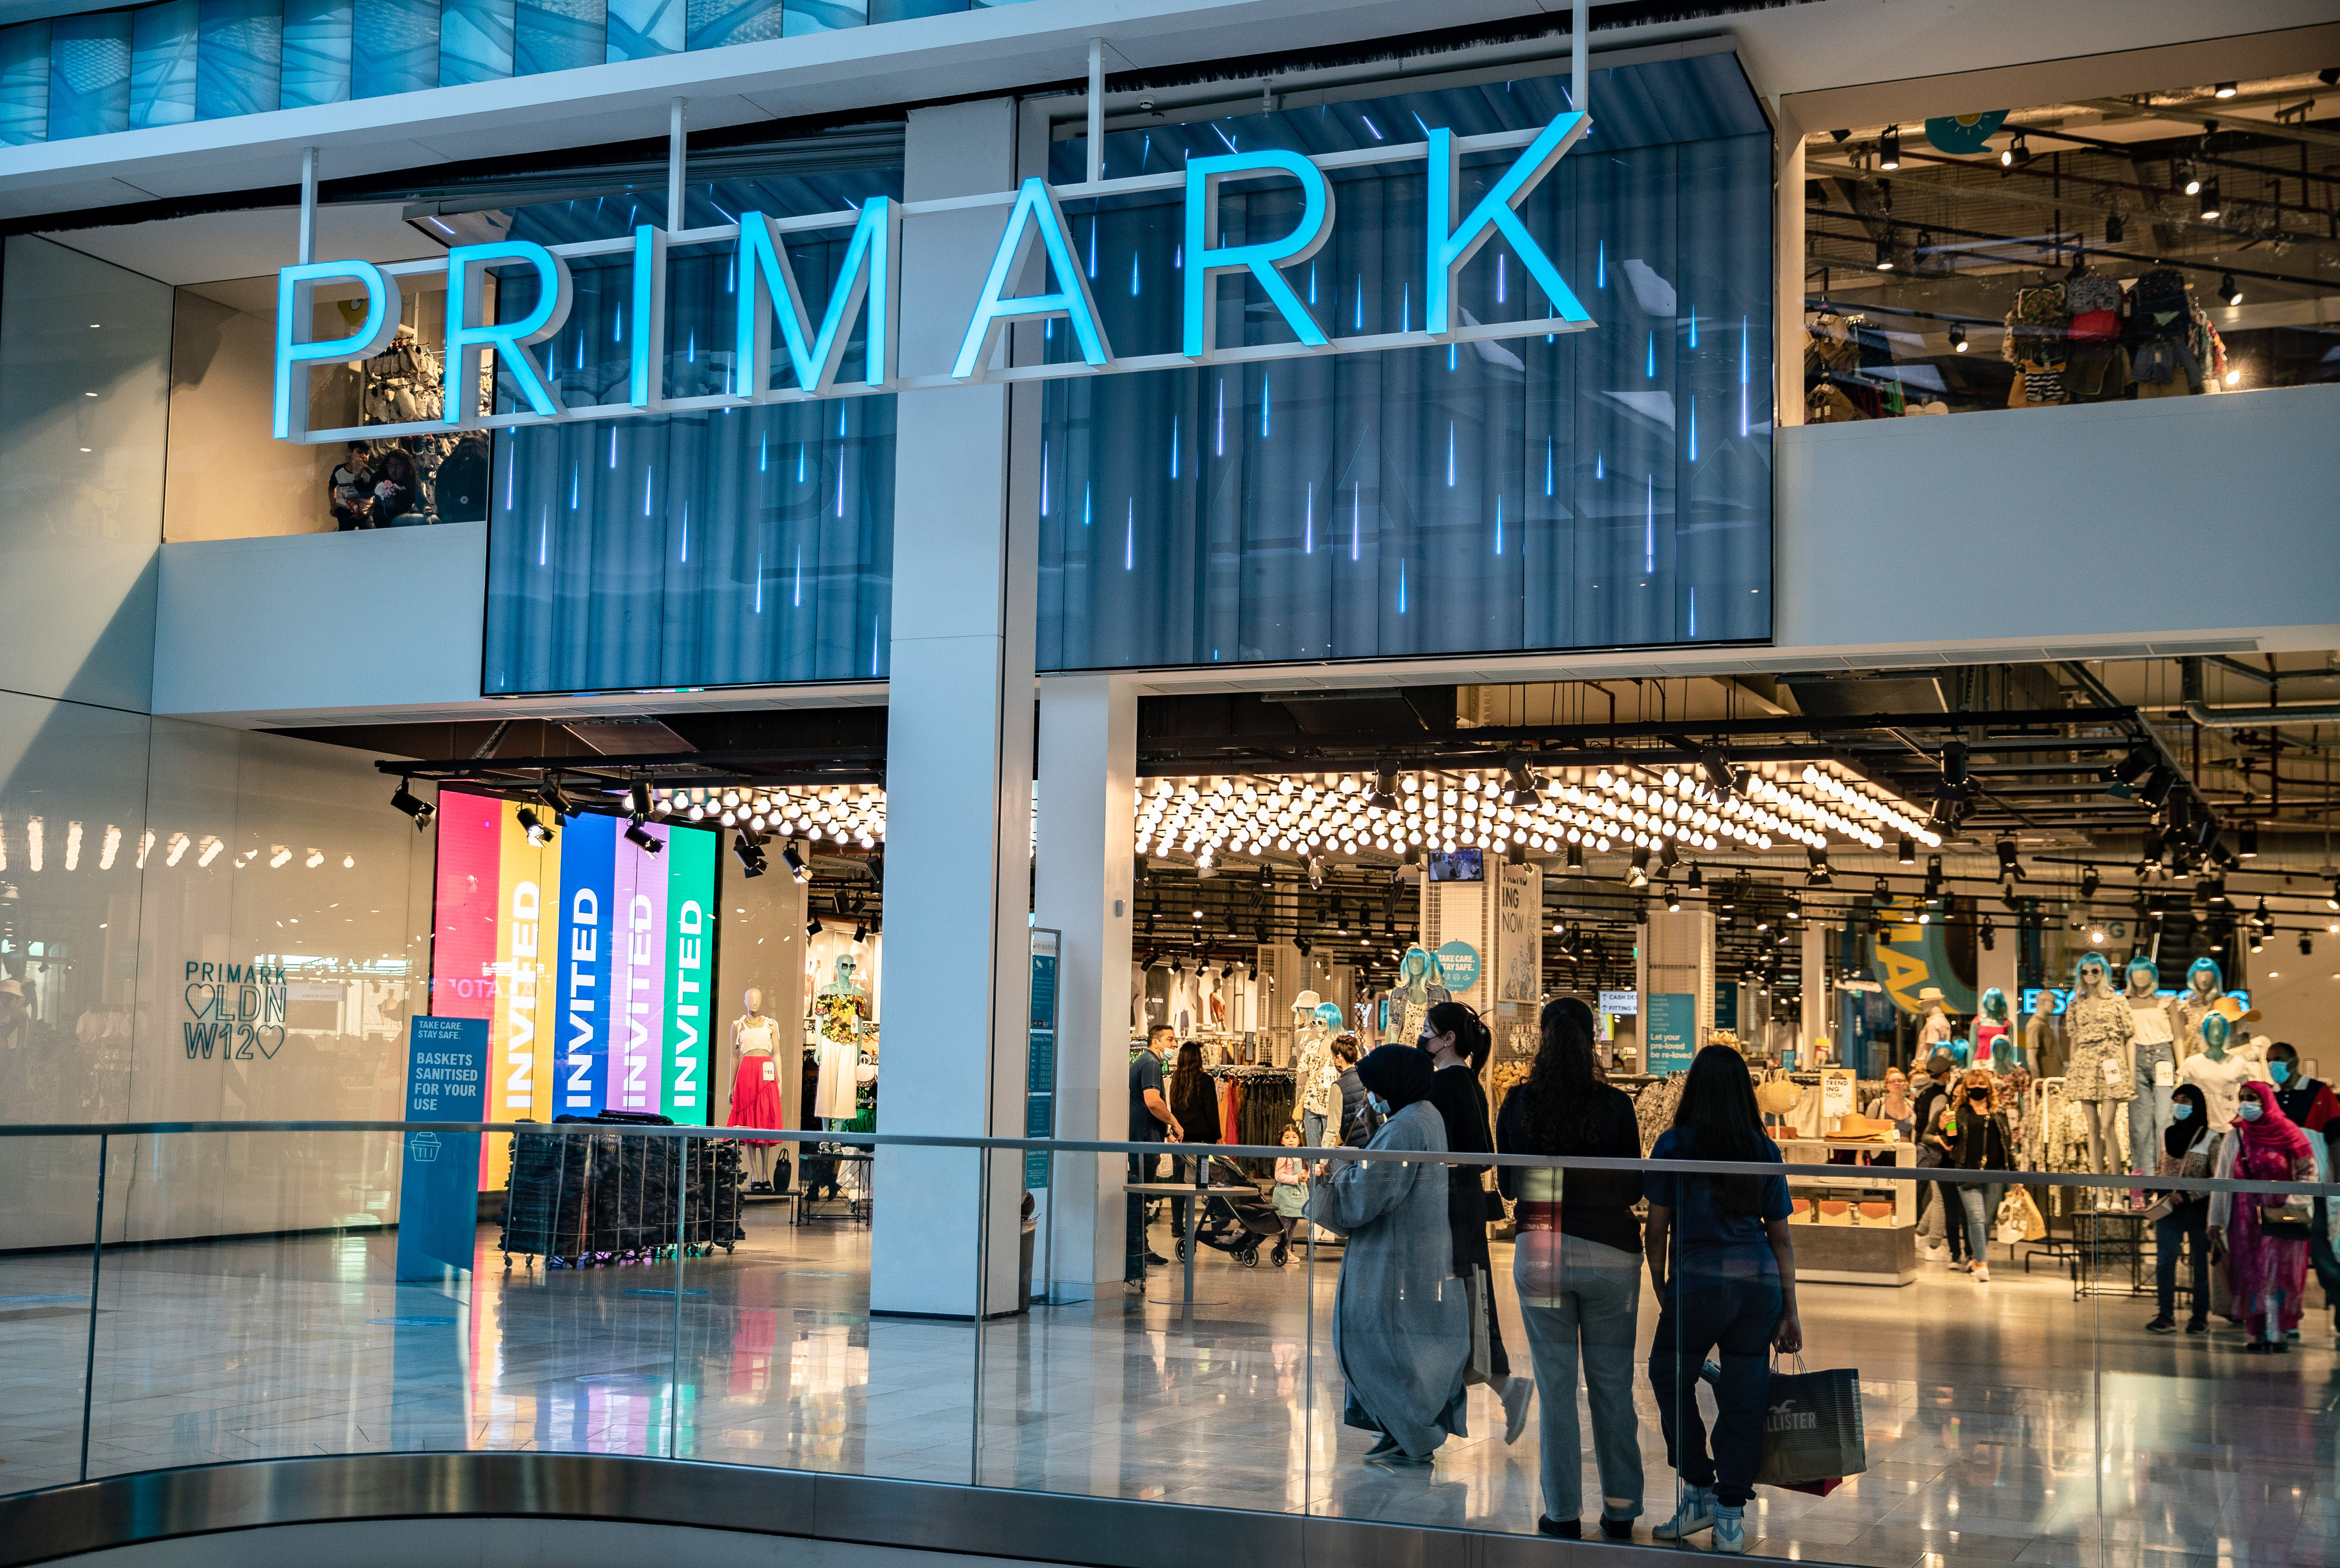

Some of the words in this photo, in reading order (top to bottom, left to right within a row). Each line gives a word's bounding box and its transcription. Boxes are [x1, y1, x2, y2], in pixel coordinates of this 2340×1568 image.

[273, 110, 1597, 440] PRIMARK
[1502, 912, 1524, 934] NOW
[185, 961, 288, 986] PRIMARK
[1441, 963, 1455, 971] TAY
[215, 984, 287, 1023] LDN
[506, 881, 540, 1108] INVITED
[566, 888, 599, 1108] INVITED
[623, 893, 653, 1107] INVITED
[674, 899, 702, 1107] INVITED
[418, 1030, 438, 1038] STAY
[439, 1031, 461, 1040] SAFE.
[419, 1021, 439, 1029] TAKE
[440, 1021, 463, 1030] CARE.
[183, 1022, 255, 1060] W12
[416, 1052, 473, 1066] BASKETS
[416, 1067, 478, 1081] SANITISED
[415, 1083, 439, 1095] FOR
[444, 1083, 476, 1097] YOUR
[414, 1098, 438, 1111] USE
[1763, 1411, 1817, 1432] LLISTER
